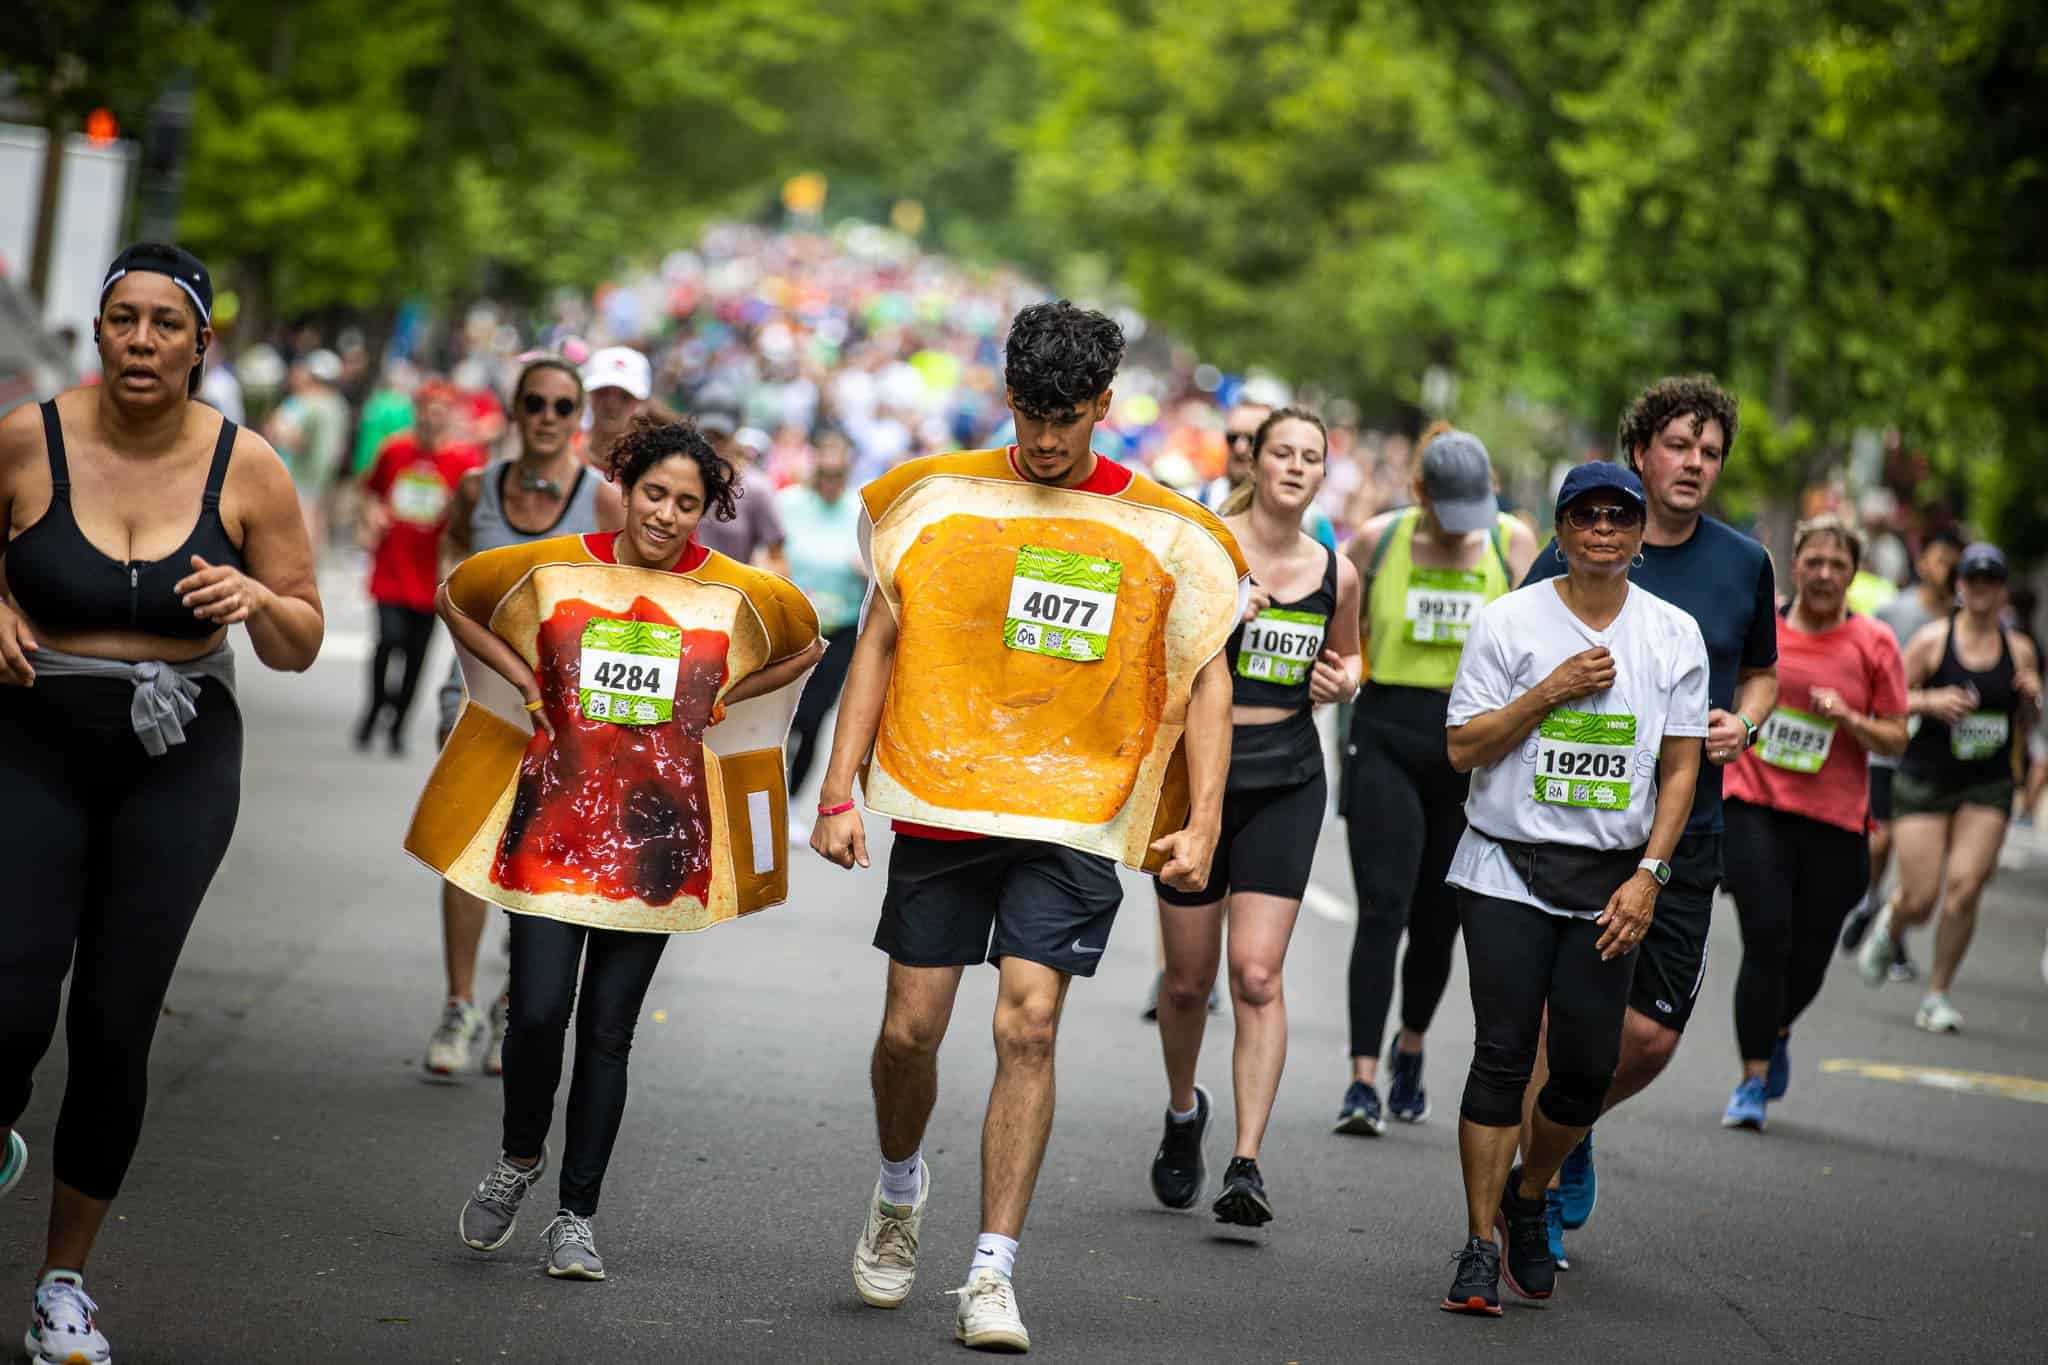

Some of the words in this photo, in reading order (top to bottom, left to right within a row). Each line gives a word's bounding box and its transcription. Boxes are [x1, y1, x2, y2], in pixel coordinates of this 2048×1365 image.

[1023, 592, 1099, 627] 4077
[1418, 598, 1472, 619] 9937
[1250, 628, 1319, 657] 10678
[594, 661, 661, 693] 4284
[1544, 749, 1627, 778] 19203
[1549, 785, 1563, 798] RA
